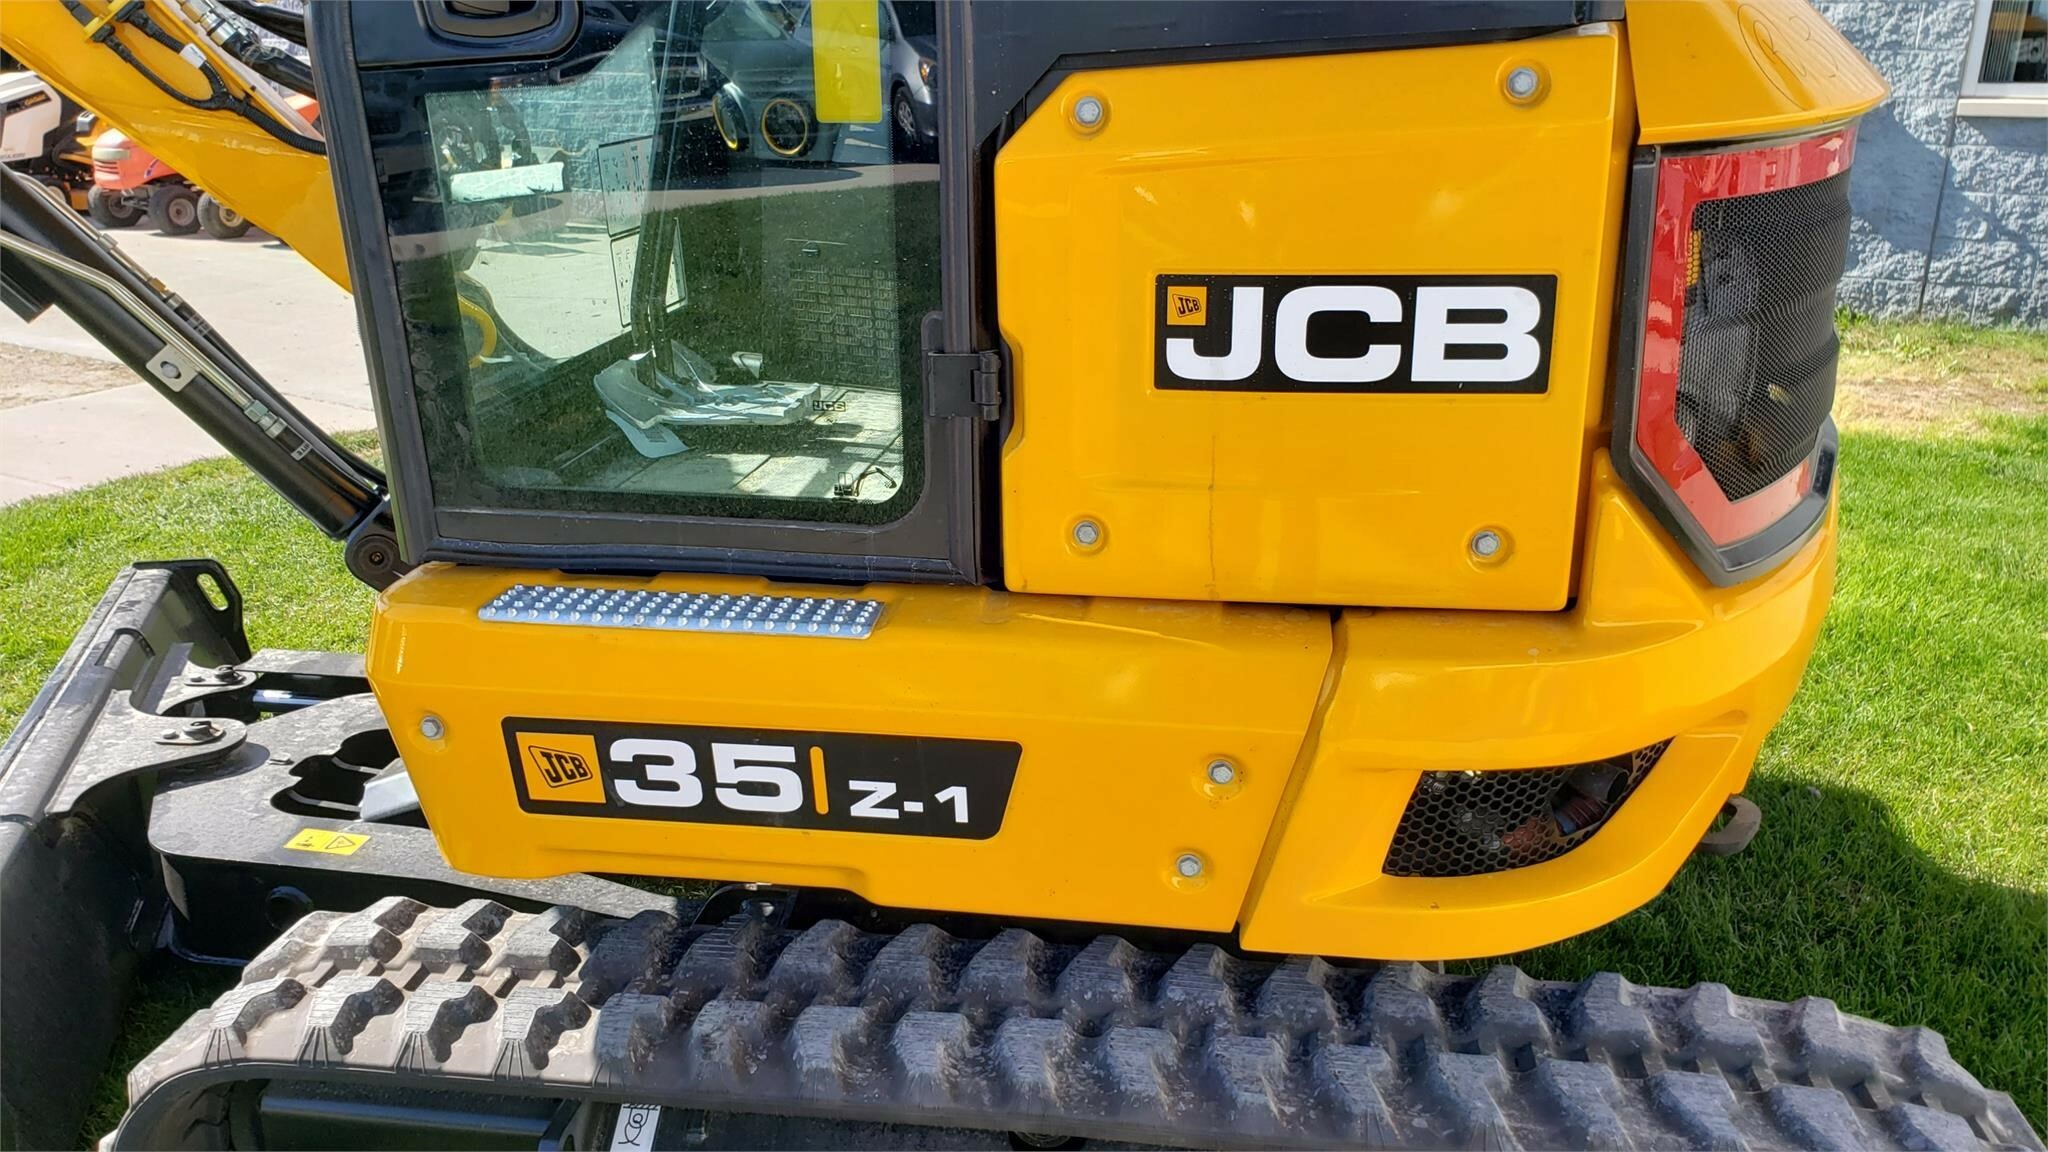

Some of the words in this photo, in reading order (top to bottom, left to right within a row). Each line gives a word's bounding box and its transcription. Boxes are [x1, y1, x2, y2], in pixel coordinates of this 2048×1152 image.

[1166, 285, 1541, 382] JCB
[1177, 296, 1200, 315] JCB
[539, 750, 590, 784] JCB
[609, 738, 804, 813] 35
[848, 779, 969, 824] Z-1
